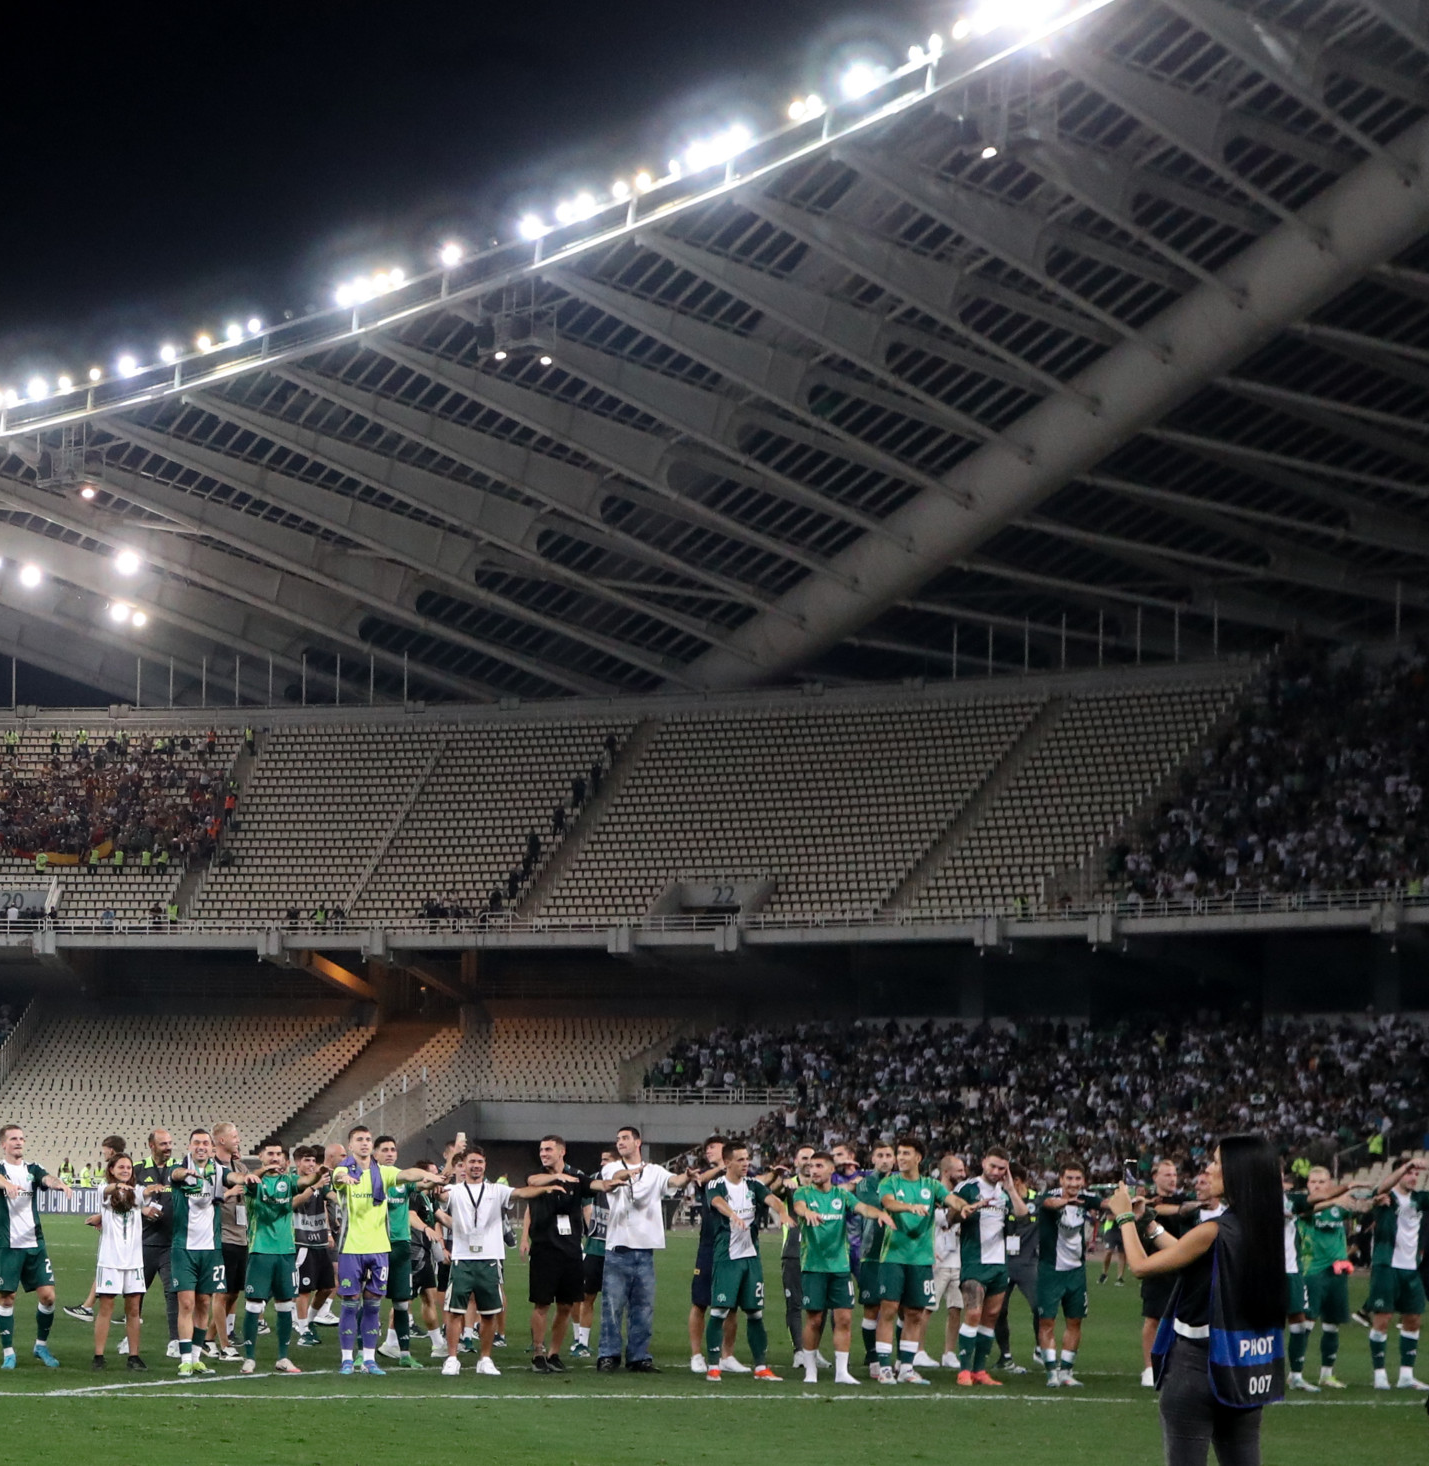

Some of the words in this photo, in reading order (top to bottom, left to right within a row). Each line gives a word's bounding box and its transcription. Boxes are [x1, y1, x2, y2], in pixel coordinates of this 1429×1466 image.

[1, 892, 24, 910] 20
[712, 886, 735, 904] 22
[71, 1189, 83, 1212] OF
[213, 1264, 226, 1282] 27
[1239, 1336, 1274, 1358] PHOT
[1248, 1374, 1272, 1395] 007
